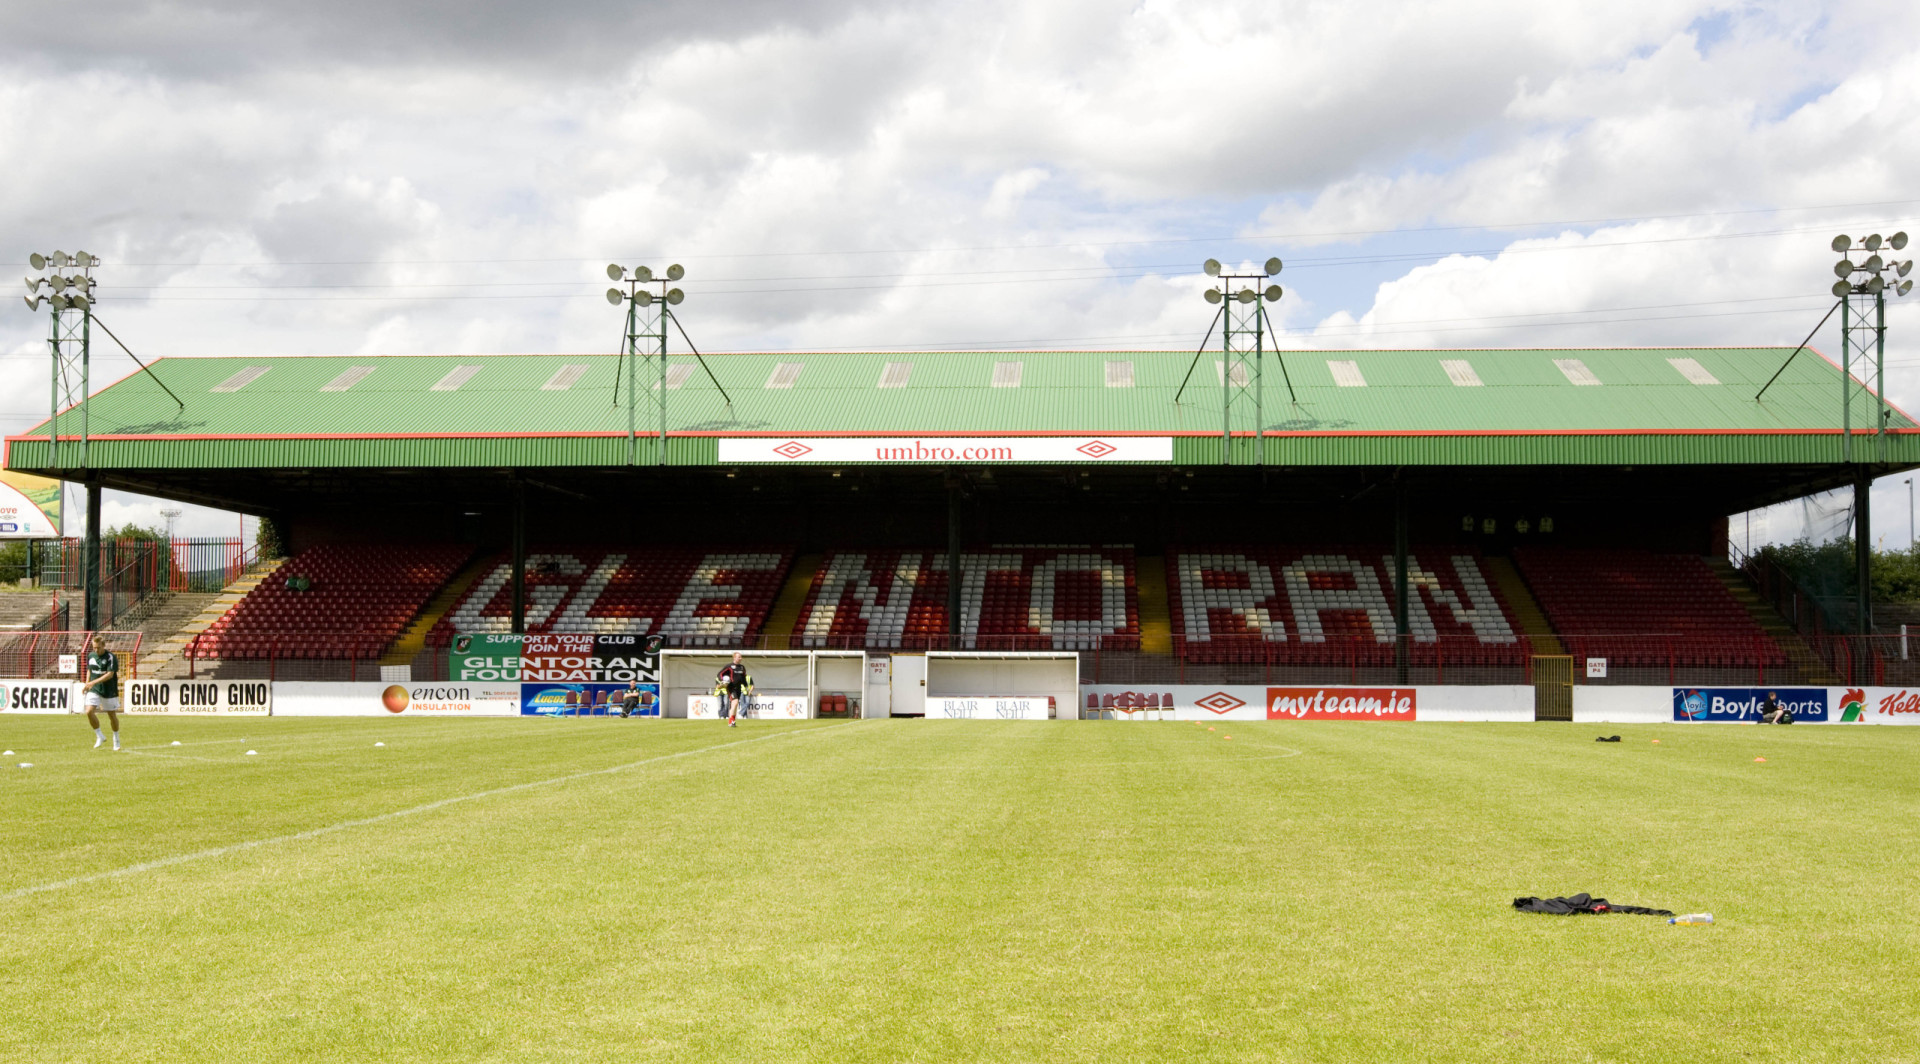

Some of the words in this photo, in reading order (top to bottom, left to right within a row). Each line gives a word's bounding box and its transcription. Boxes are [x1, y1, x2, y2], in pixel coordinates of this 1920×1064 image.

[876, 440, 1013, 460] umbro.com
[486, 635, 551, 644] SUPPORT
[556, 635, 594, 644] YOUR
[598, 636, 635, 644] CLUB
[527, 644, 559, 654] JOIN
[563, 645, 591, 653] THE
[463, 656, 653, 669] GLENTORAN
[461, 669, 660, 681] FOUNDATION
[11, 686, 68, 709] SCREEN
[131, 683, 170, 706] GINO
[180, 683, 218, 706] GINO
[228, 683, 267, 706] GINO
[412, 687, 470, 700] encon
[412, 703, 471, 711] INSULATION
[944, 701, 978, 710] BLAIR
[996, 701, 1030, 710] BLAIR
[1271, 690, 1411, 718] myteam.ie
[944, 709, 975, 718] NEILL
[996, 709, 1028, 718] NEILL
